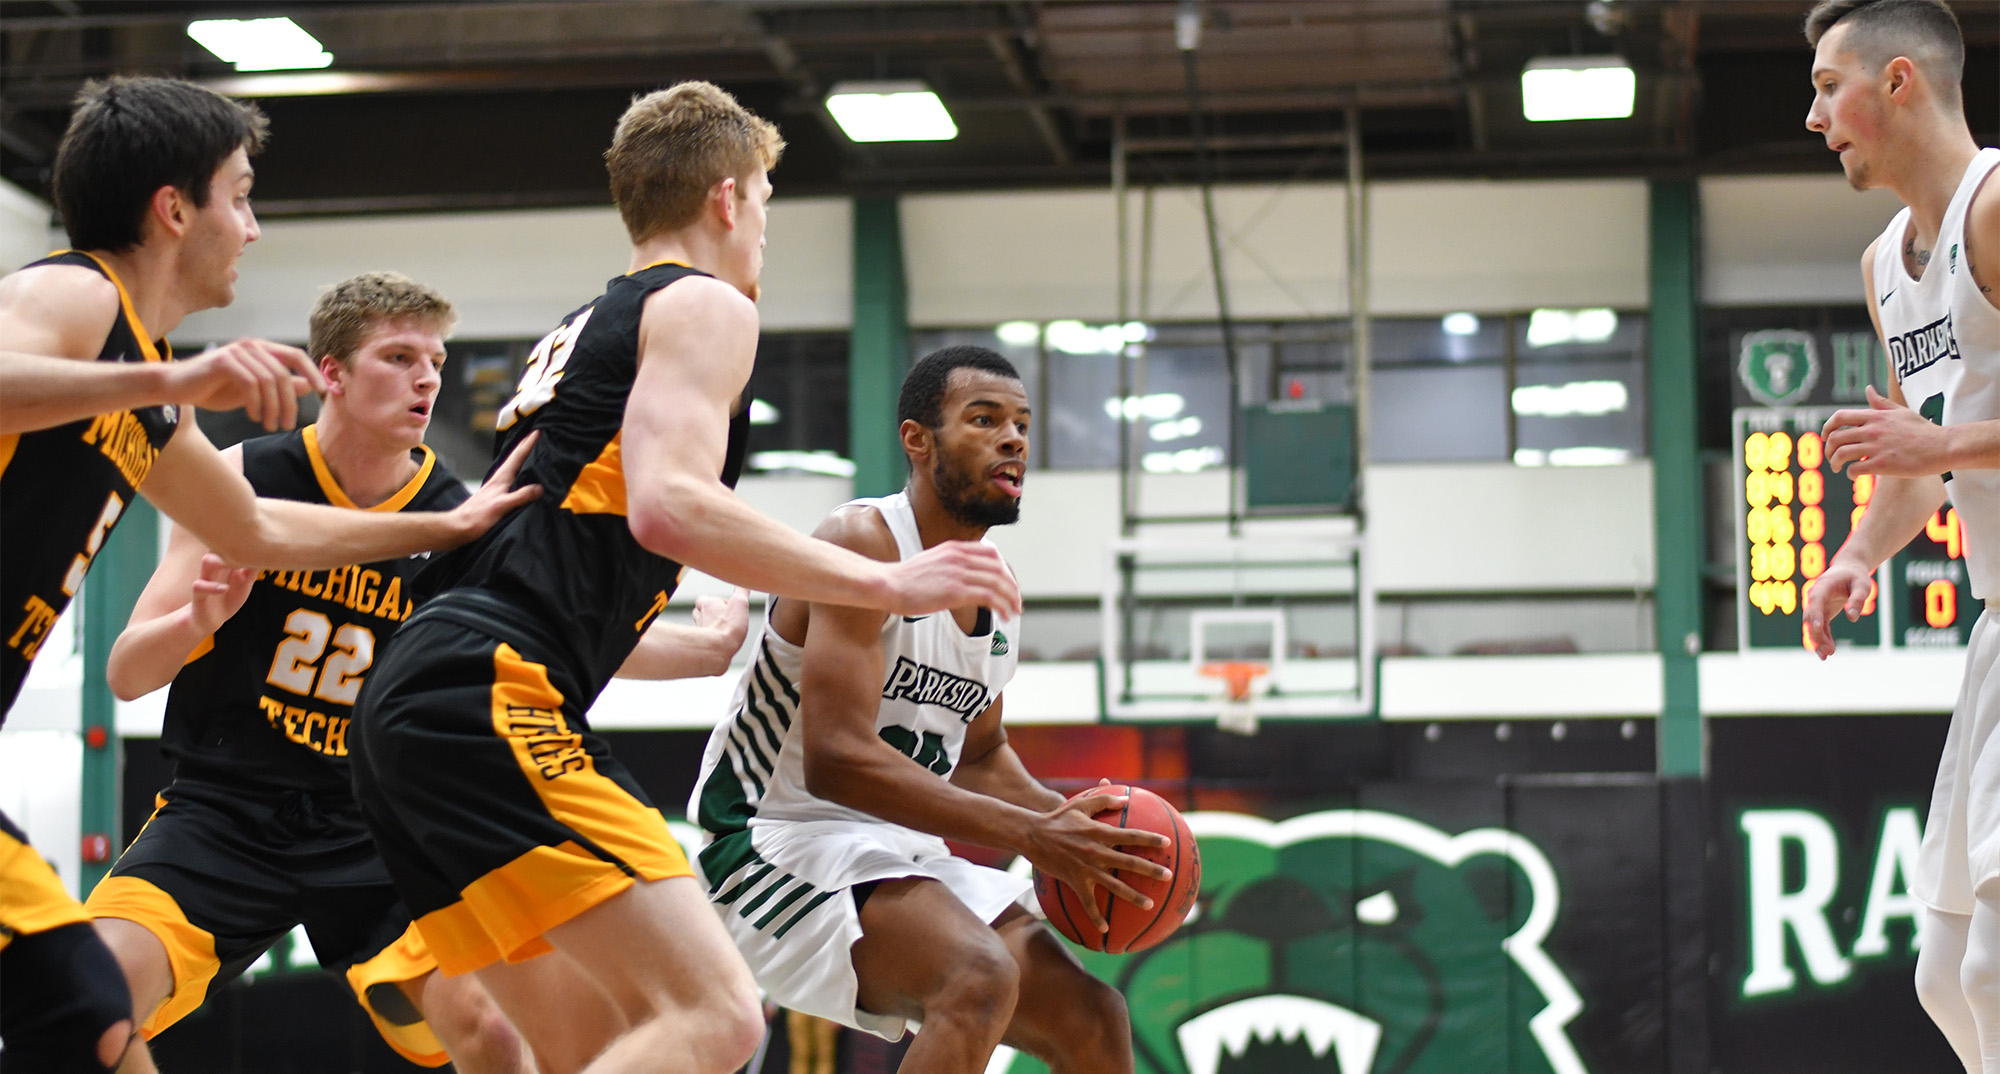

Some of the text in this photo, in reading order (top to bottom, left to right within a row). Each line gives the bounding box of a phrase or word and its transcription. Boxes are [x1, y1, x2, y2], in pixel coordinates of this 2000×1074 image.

[1888, 312, 1961, 387] PARKSE
[1925, 508, 1970, 560] 4
[1925, 579, 1957, 628] 0
[265, 607, 376, 706] 22
[259, 694, 351, 757] TECH
